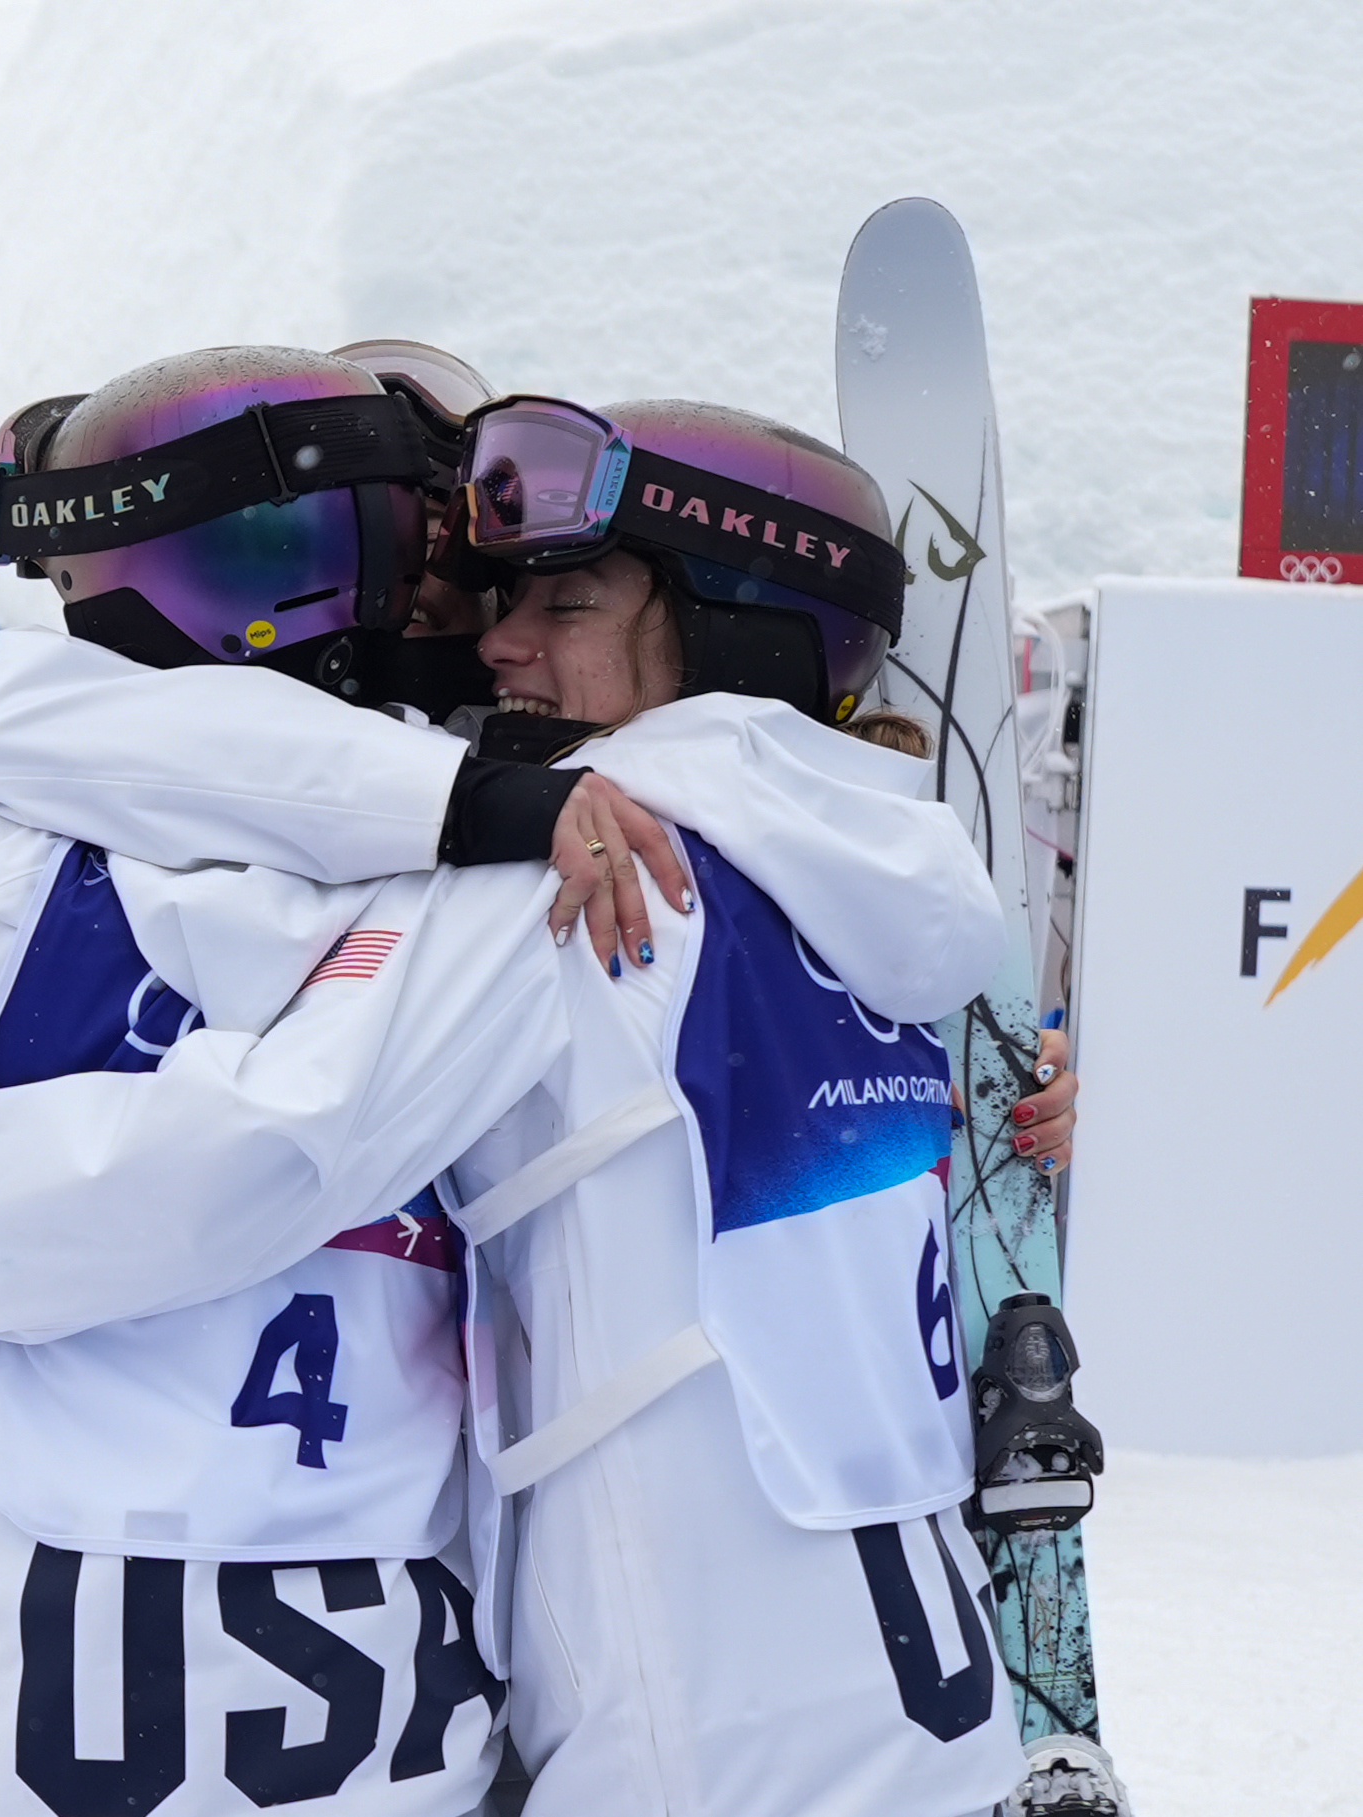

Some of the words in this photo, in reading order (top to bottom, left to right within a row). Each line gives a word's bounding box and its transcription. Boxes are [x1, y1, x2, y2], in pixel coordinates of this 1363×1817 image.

[11, 472, 171, 528] OAKLEY
[603, 457, 626, 507] OAKLEY
[641, 482, 851, 568] OAKLEY
[807, 1075, 908, 1109] MILANO
[916, 1219, 960, 1401] 6
[231, 1292, 348, 1470] 4
[16, 1541, 507, 1817] USA
